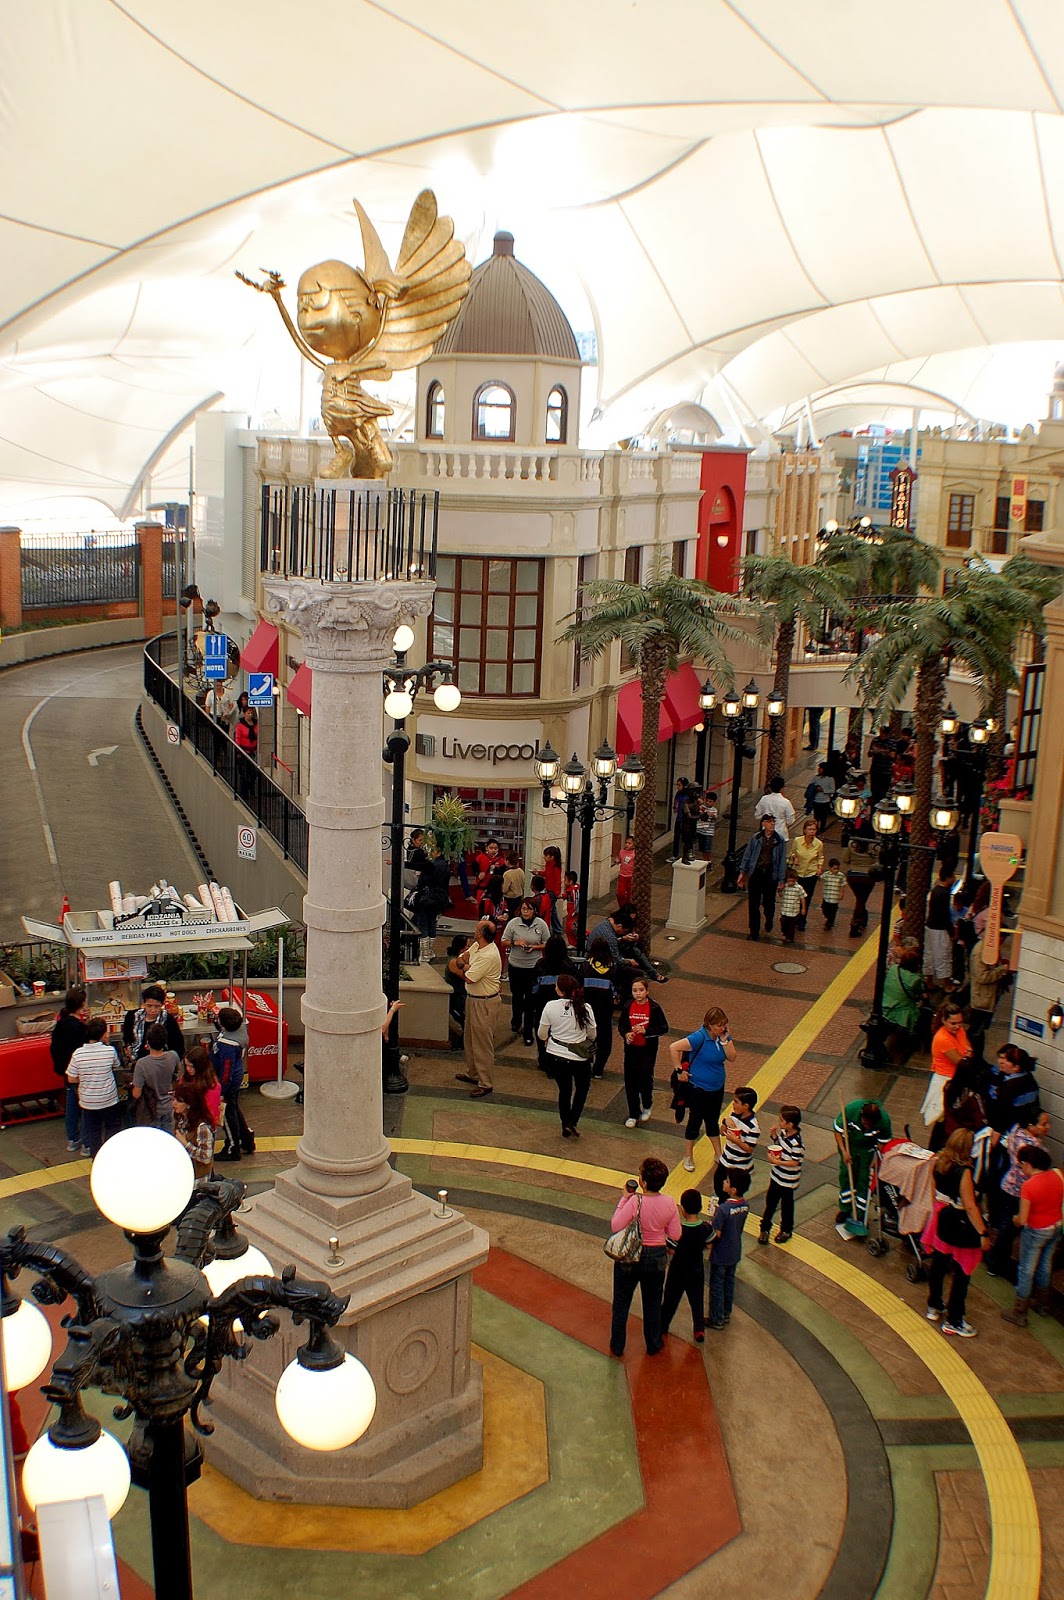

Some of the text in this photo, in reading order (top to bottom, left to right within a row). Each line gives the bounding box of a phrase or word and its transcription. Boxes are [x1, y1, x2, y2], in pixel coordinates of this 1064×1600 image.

[895, 474, 906, 528] TEATRO
[442, 736, 540, 766] Liverpool
[242, 832, 252, 842] 60
[991, 887, 1000, 911] Cocina
[147, 912, 181, 920] KIDZANIA
[81, 935, 114, 943] PALOMITAS
[121, 932, 146, 940] BEBIDAS
